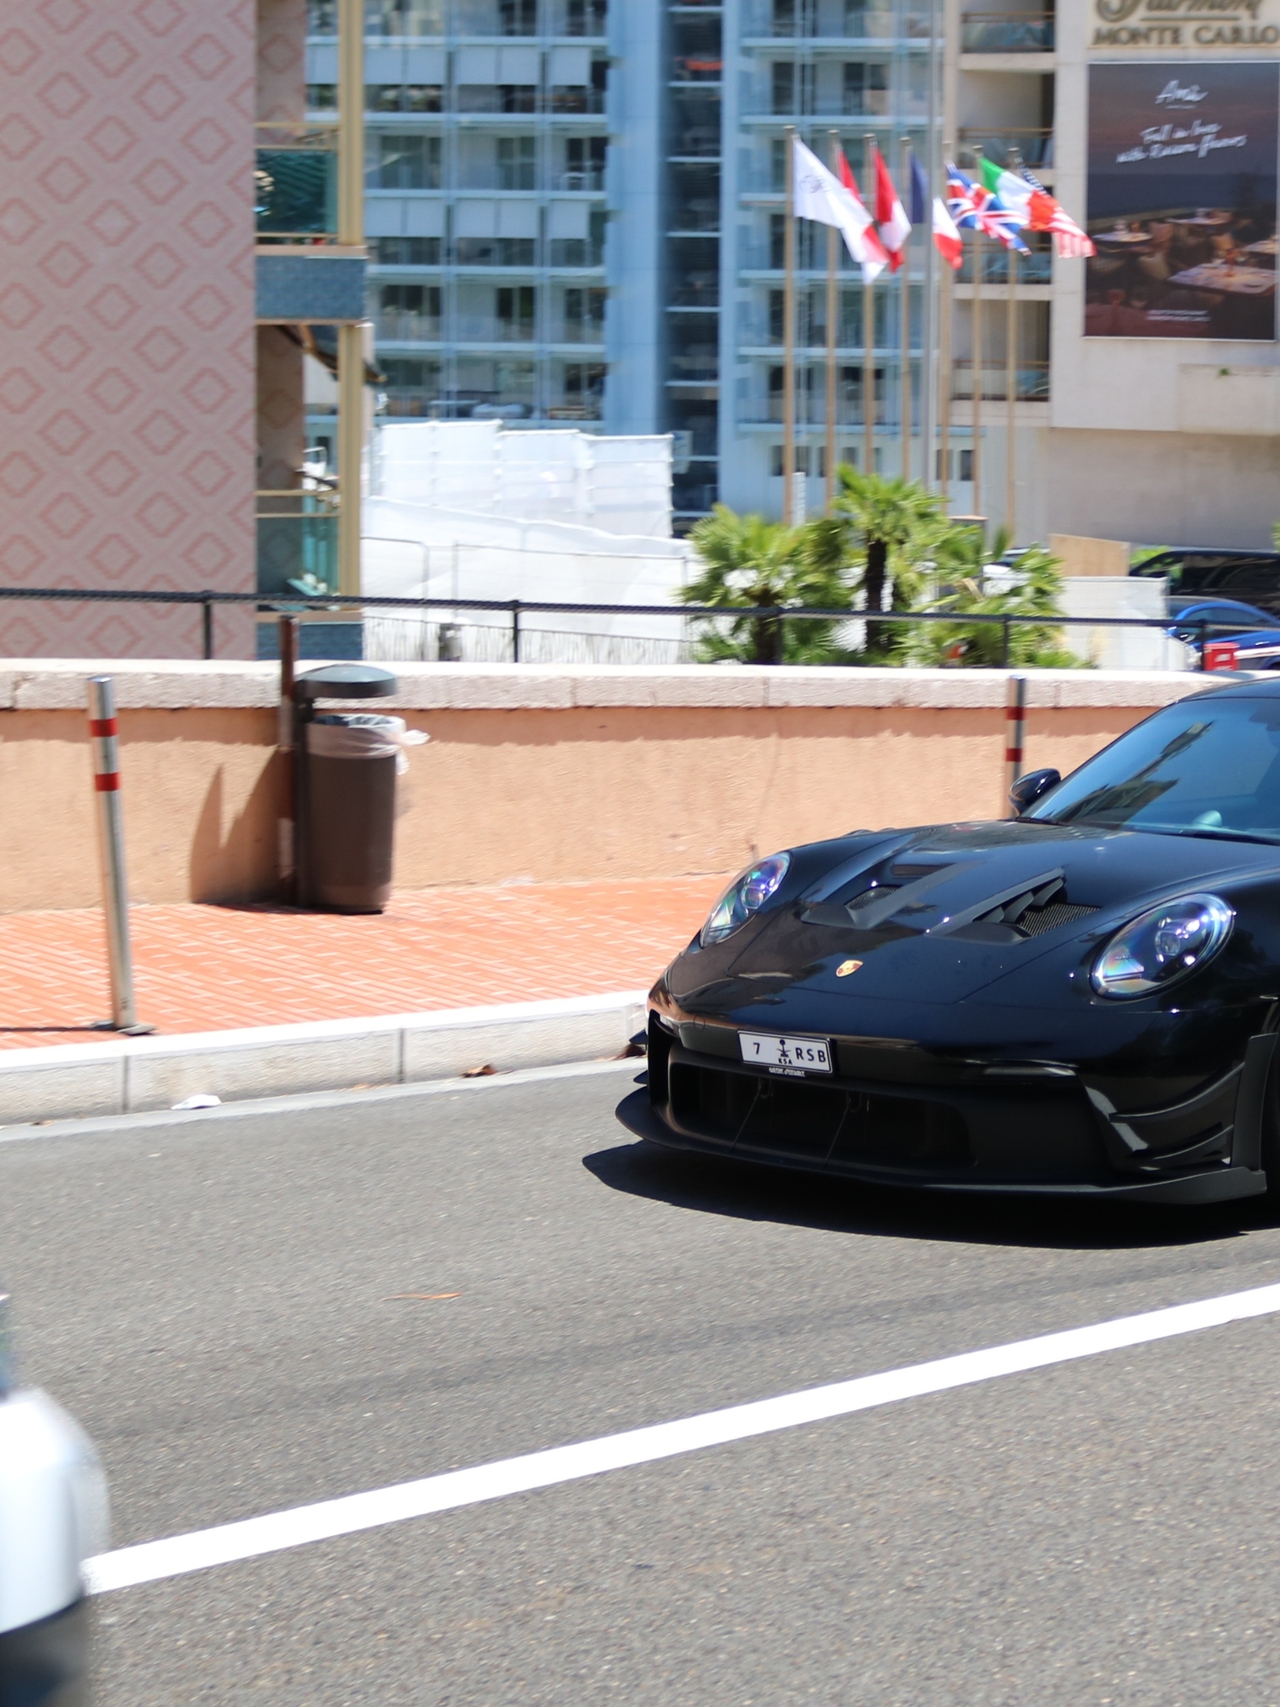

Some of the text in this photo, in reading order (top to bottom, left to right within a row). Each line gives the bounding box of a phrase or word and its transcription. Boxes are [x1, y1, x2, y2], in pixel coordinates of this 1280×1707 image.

[1092, 24, 1280, 46] MONTE CARLO
[753, 1042, 827, 1063] 7 RSB
[778, 1057, 793, 1065] KSA
